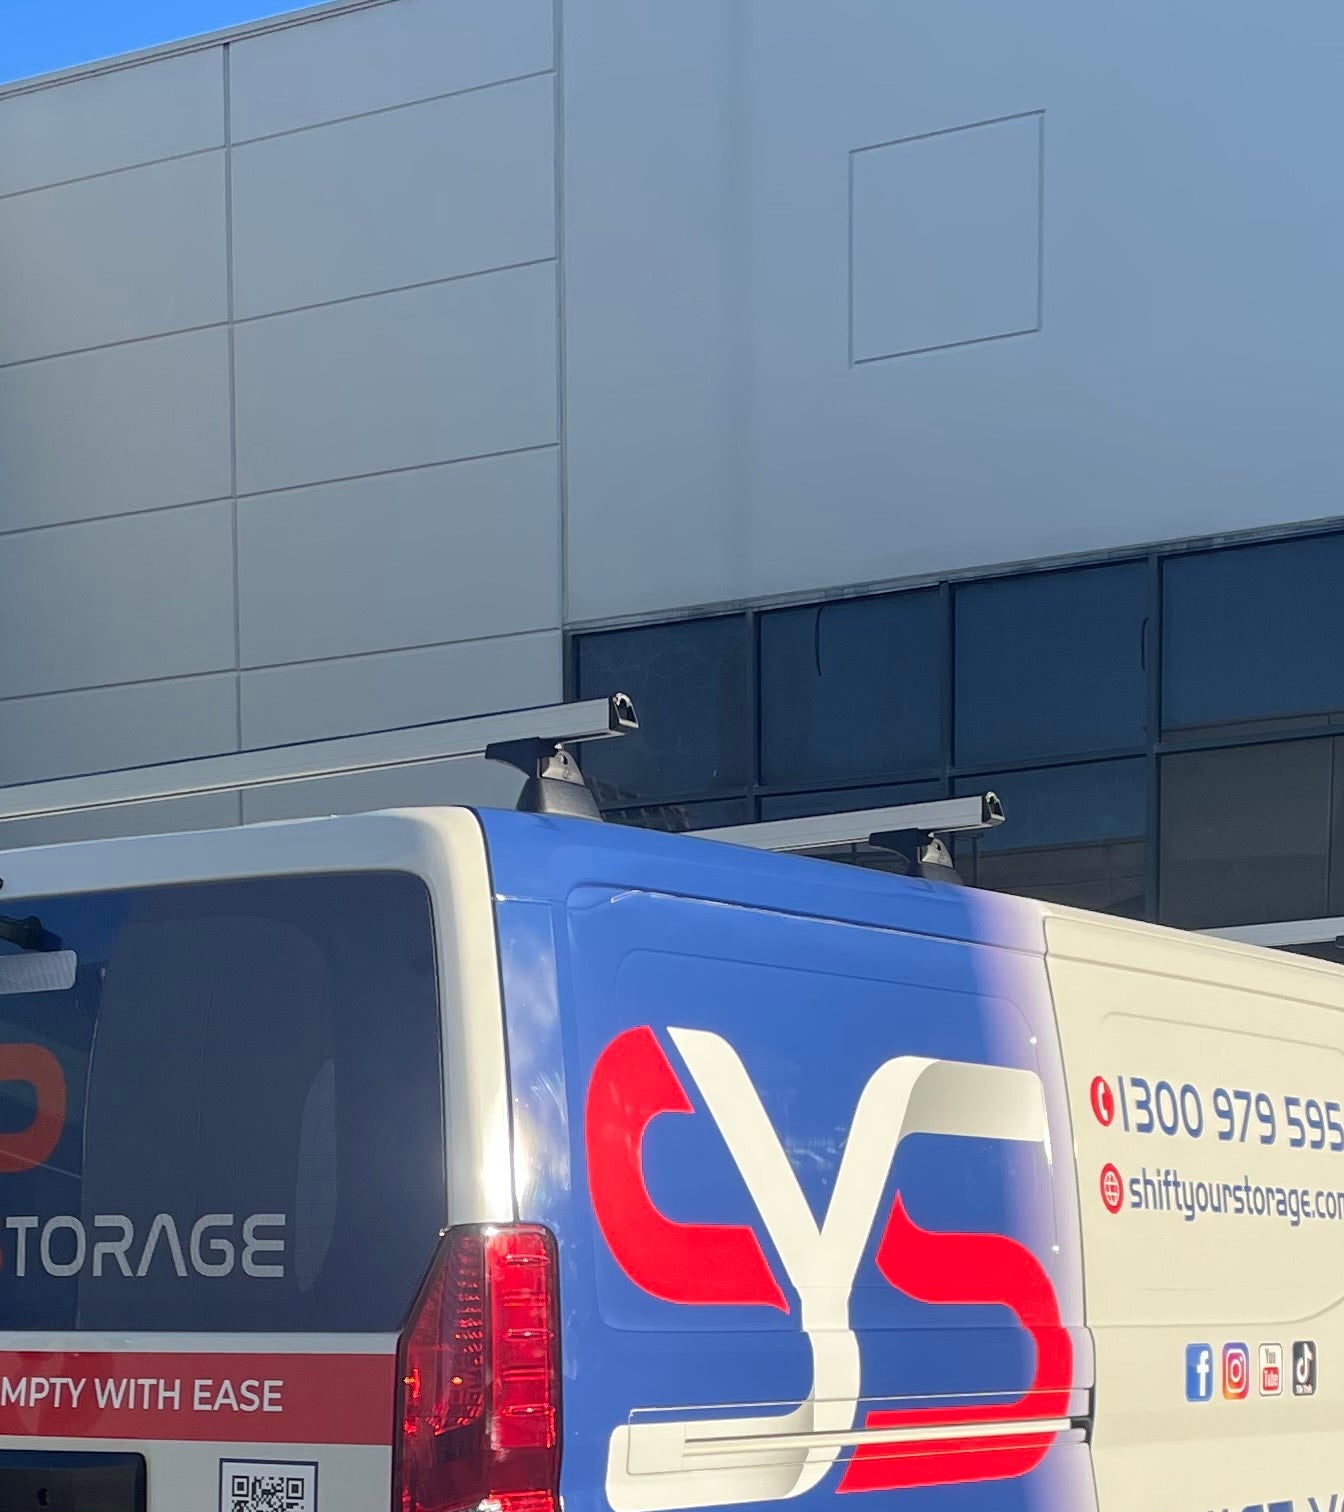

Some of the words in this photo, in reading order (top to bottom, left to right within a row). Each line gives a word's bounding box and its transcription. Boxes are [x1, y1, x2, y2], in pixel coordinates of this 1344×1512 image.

[1117, 1075, 1203, 1139] 1300
[1212, 1087, 1276, 1145] 979
[1264, 1348, 1276, 1364] You
[1263, 1370, 1279, 1388] Tube
[94, 1378, 181, 1410] WITH
[193, 1379, 283, 1412] EASE
